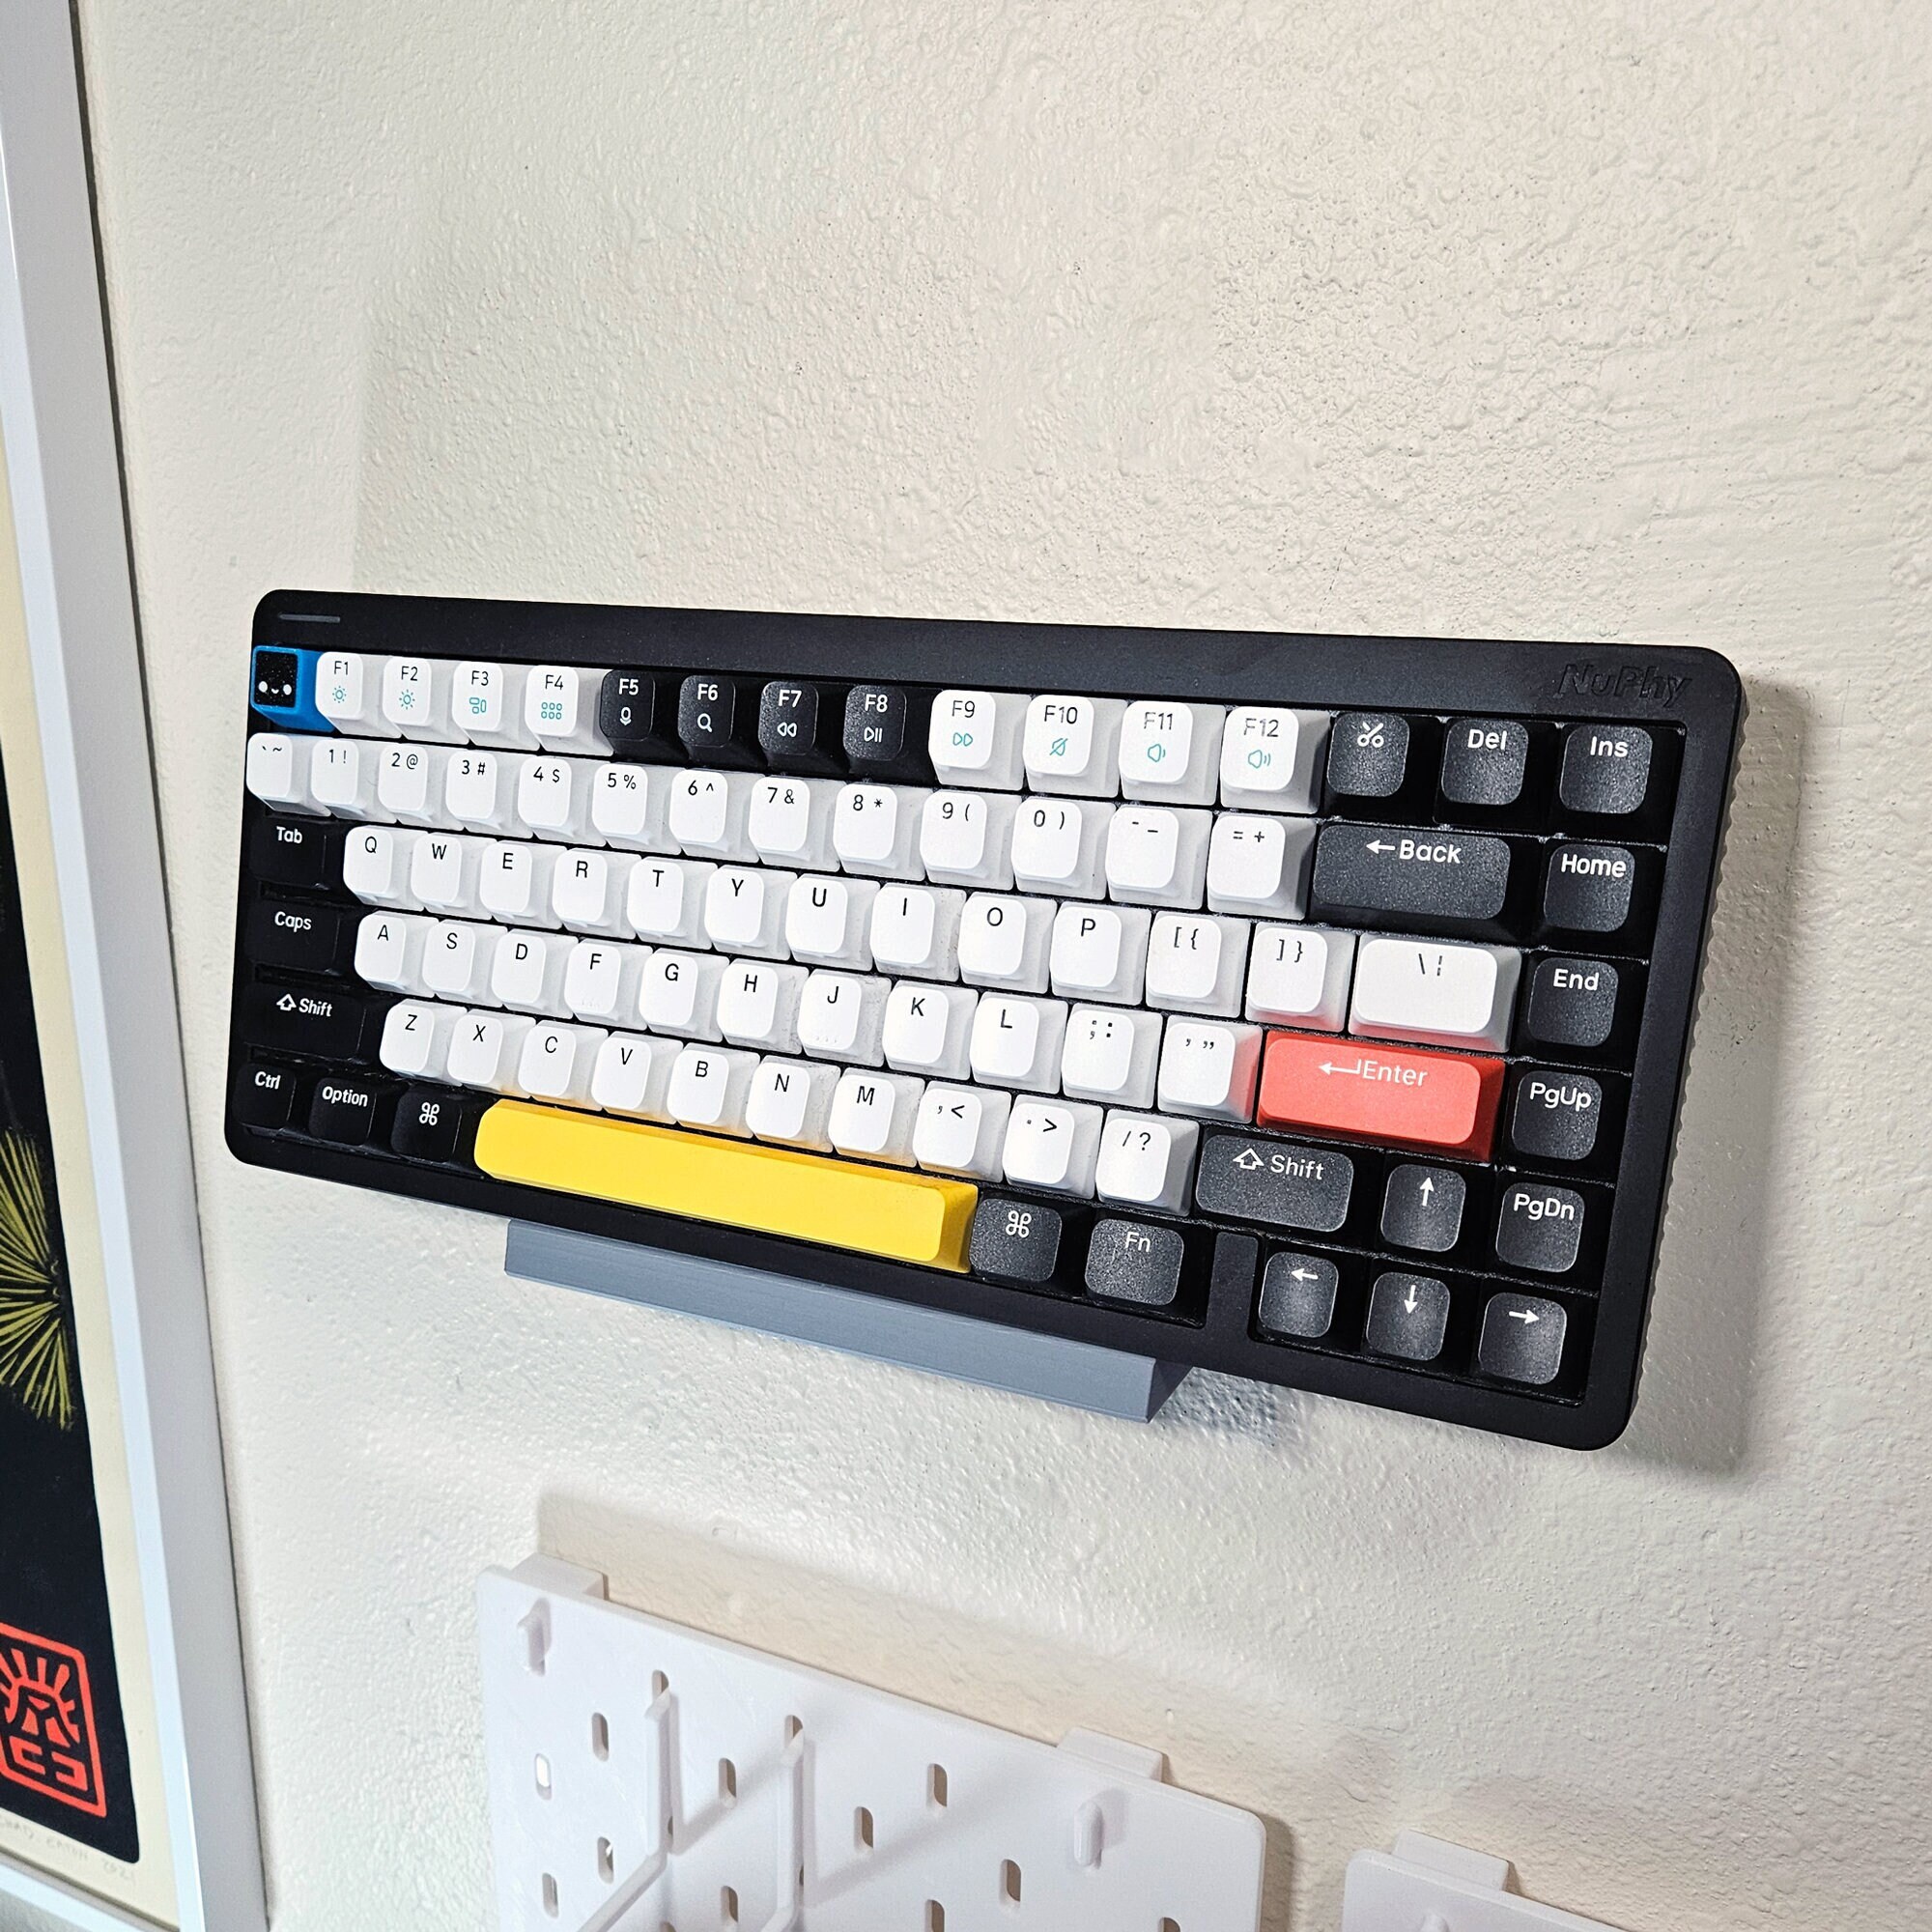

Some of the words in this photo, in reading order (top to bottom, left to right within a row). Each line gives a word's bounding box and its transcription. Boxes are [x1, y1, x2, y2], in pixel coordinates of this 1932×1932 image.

[333, 660, 349, 676] F1
[401, 665, 418, 682] F2
[470, 669, 489, 687] F3
[545, 673, 564, 691] F4
[618, 677, 639, 696] F5
[696, 683, 719, 701] F6
[1551, 664, 1692, 708] NuPhy
[778, 688, 803, 708] F7
[864, 693, 888, 713] F8
[952, 699, 976, 719] F9
[1043, 704, 1078, 724] F10
[1143, 711, 1174, 731] F11
[1243, 717, 1279, 738] F12
[1467, 729, 1507, 751] Del
[1591, 735, 1629, 757] Ins
[328, 749, 334, 764] 1
[391, 752, 401, 768] 2
[406, 753, 419, 770] @
[461, 759, 470, 776] 3
[477, 761, 486, 776] #
[532, 766, 544, 781] 4
[552, 768, 560, 783] $
[607, 772, 617, 788] 5
[623, 774, 637, 790] %
[687, 780, 698, 796] 6
[767, 786, 779, 804] 7
[783, 788, 795, 805] &
[852, 794, 864, 811] 8
[942, 802, 954, 820] 9
[964, 803, 971, 822] (
[1033, 810, 1046, 828] 0
[1059, 810, 1065, 831] )
[276, 825, 303, 844] Tab
[364, 836, 378, 854] Q
[431, 842, 447, 861] W
[1400, 839, 1462, 864] Back
[501, 852, 514, 870] E
[575, 860, 588, 879] R
[1561, 854, 1626, 877] Home
[652, 868, 665, 888] T
[731, 877, 745, 897] Y
[811, 887, 828, 908] U
[274, 911, 312, 933] Caps
[986, 906, 1004, 927] O
[377, 923, 389, 942] A
[1080, 918, 1096, 937] P
[445, 932, 458, 950] S
[1174, 925, 1182, 949] [
[1190, 927, 1199, 951] {
[515, 943, 528, 960] D
[1276, 938, 1286, 961] ]
[1293, 940, 1303, 963] }
[589, 952, 603, 970] F
[665, 962, 680, 982] G
[1553, 969, 1599, 990] End
[743, 974, 758, 993] H
[827, 985, 839, 1005] J
[298, 997, 333, 1017] Shift
[910, 996, 925, 1017] K
[404, 1013, 418, 1032] Z
[1000, 1009, 1013, 1030] L
[472, 1024, 486, 1042] X
[545, 1036, 558, 1054] C
[620, 1047, 634, 1065] V
[695, 1060, 709, 1078] B
[1363, 1061, 1427, 1086] Enter
[254, 1070, 281, 1090] Ctrl
[774, 1073, 790, 1093] N
[322, 1086, 368, 1107] Option
[856, 1085, 876, 1106] M
[1530, 1082, 1591, 1112] PgUp
[951, 1104, 965, 1120] <
[1042, 1118, 1058, 1133] >
[1139, 1131, 1151, 1151] ?
[1271, 1155, 1323, 1179] Shift
[1514, 1193, 1575, 1220] PgDn
[1123, 1231, 1151, 1253] Fn
